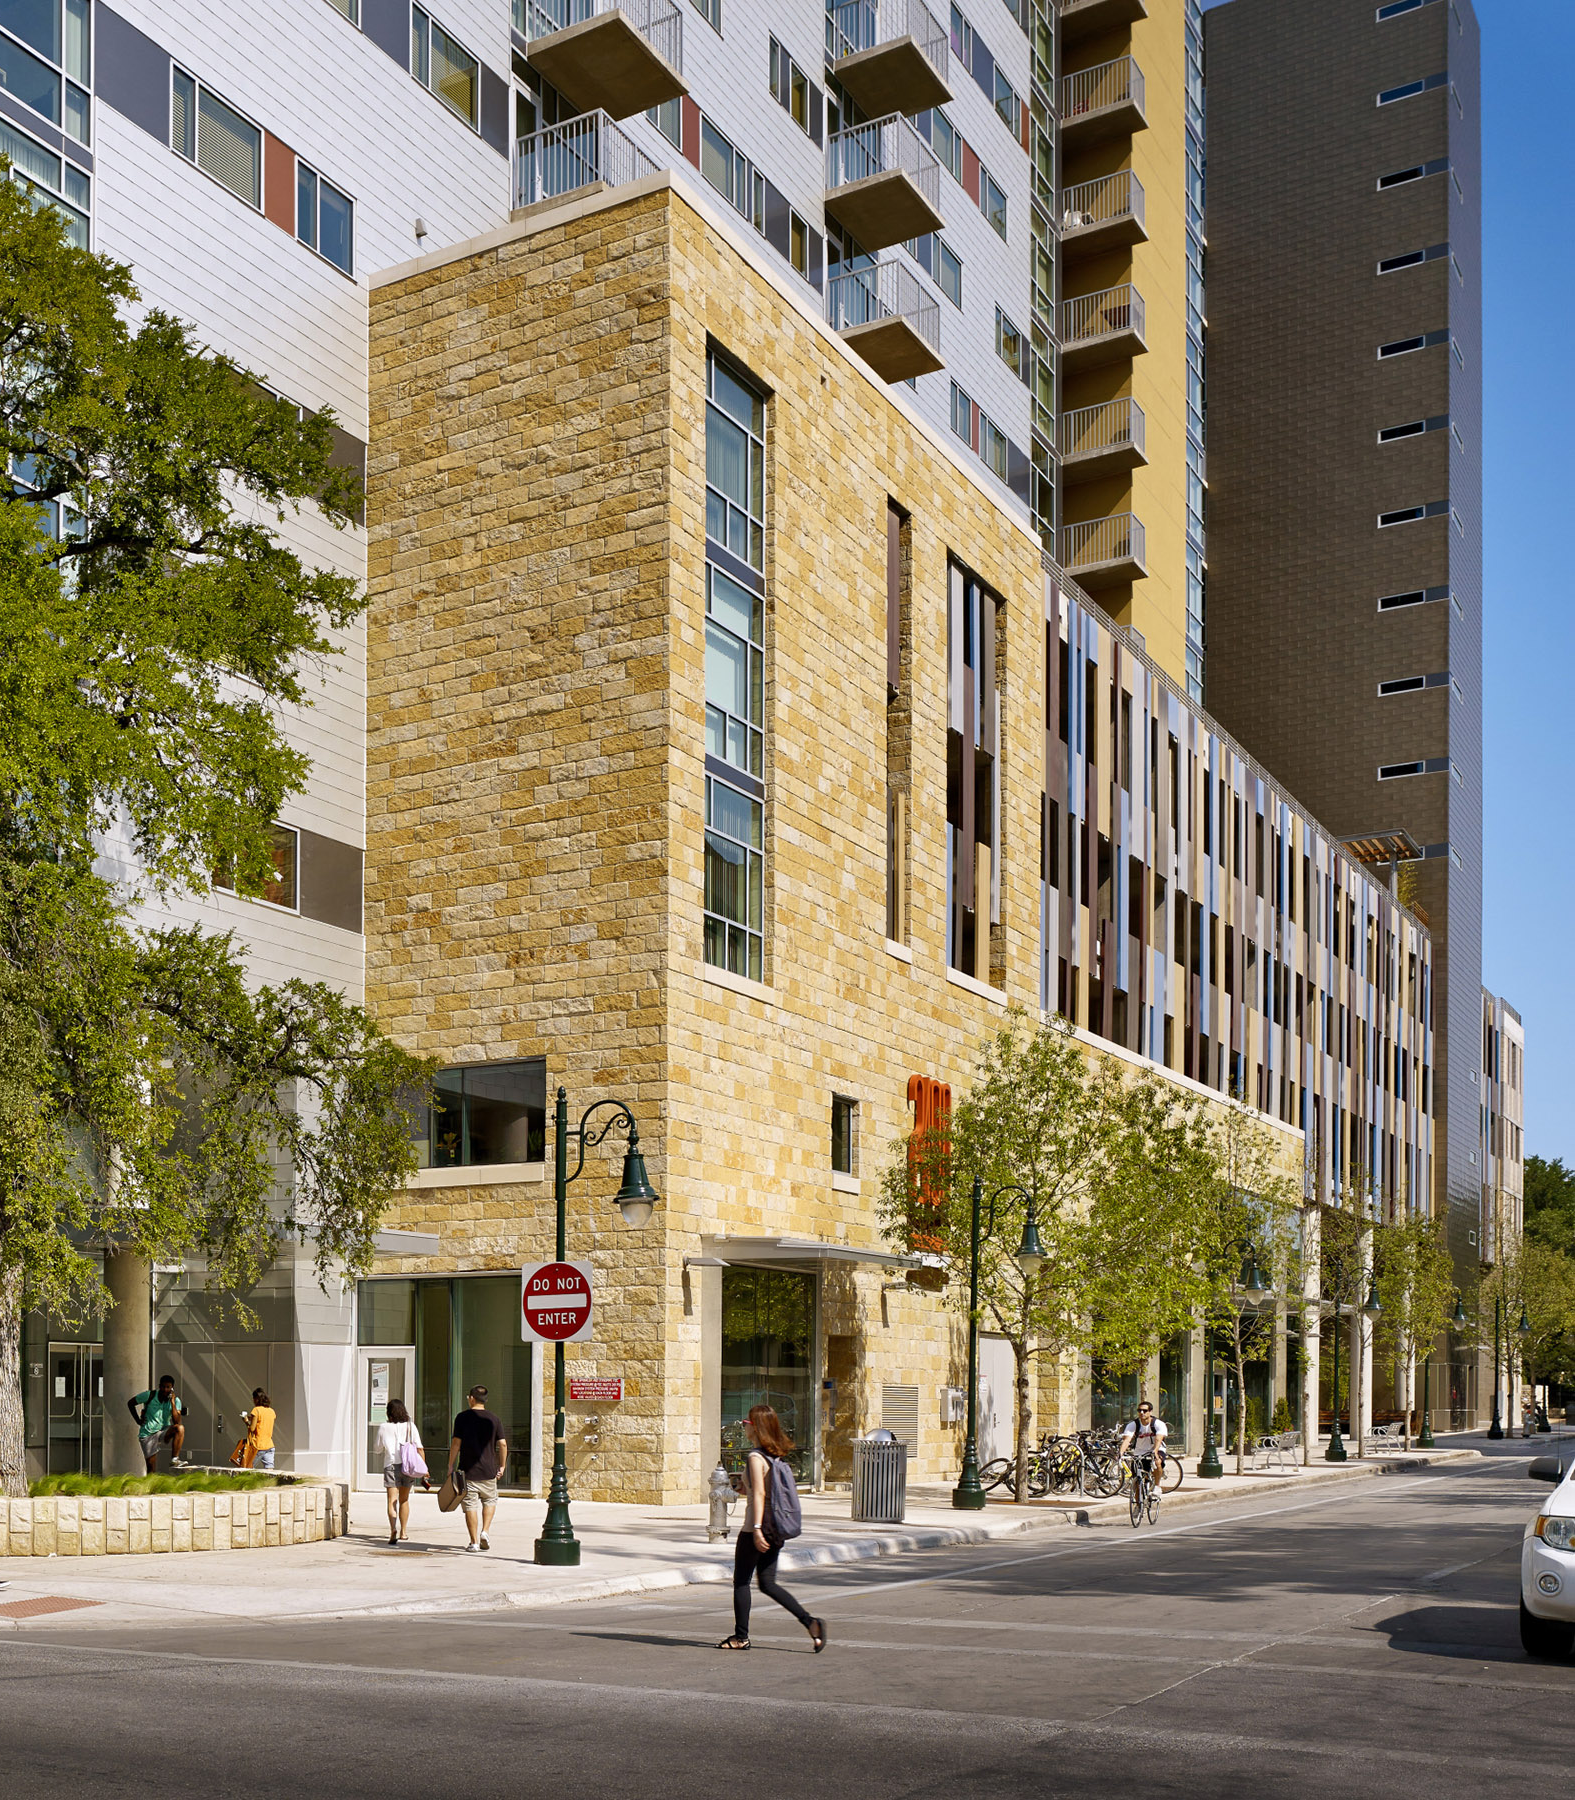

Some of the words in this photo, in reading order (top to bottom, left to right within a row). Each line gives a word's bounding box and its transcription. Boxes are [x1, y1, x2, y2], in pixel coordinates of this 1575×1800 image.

[533, 1278, 550, 1291] DO
[557, 1277, 581, 1290] NOT
[538, 1312, 577, 1326] ENTER
